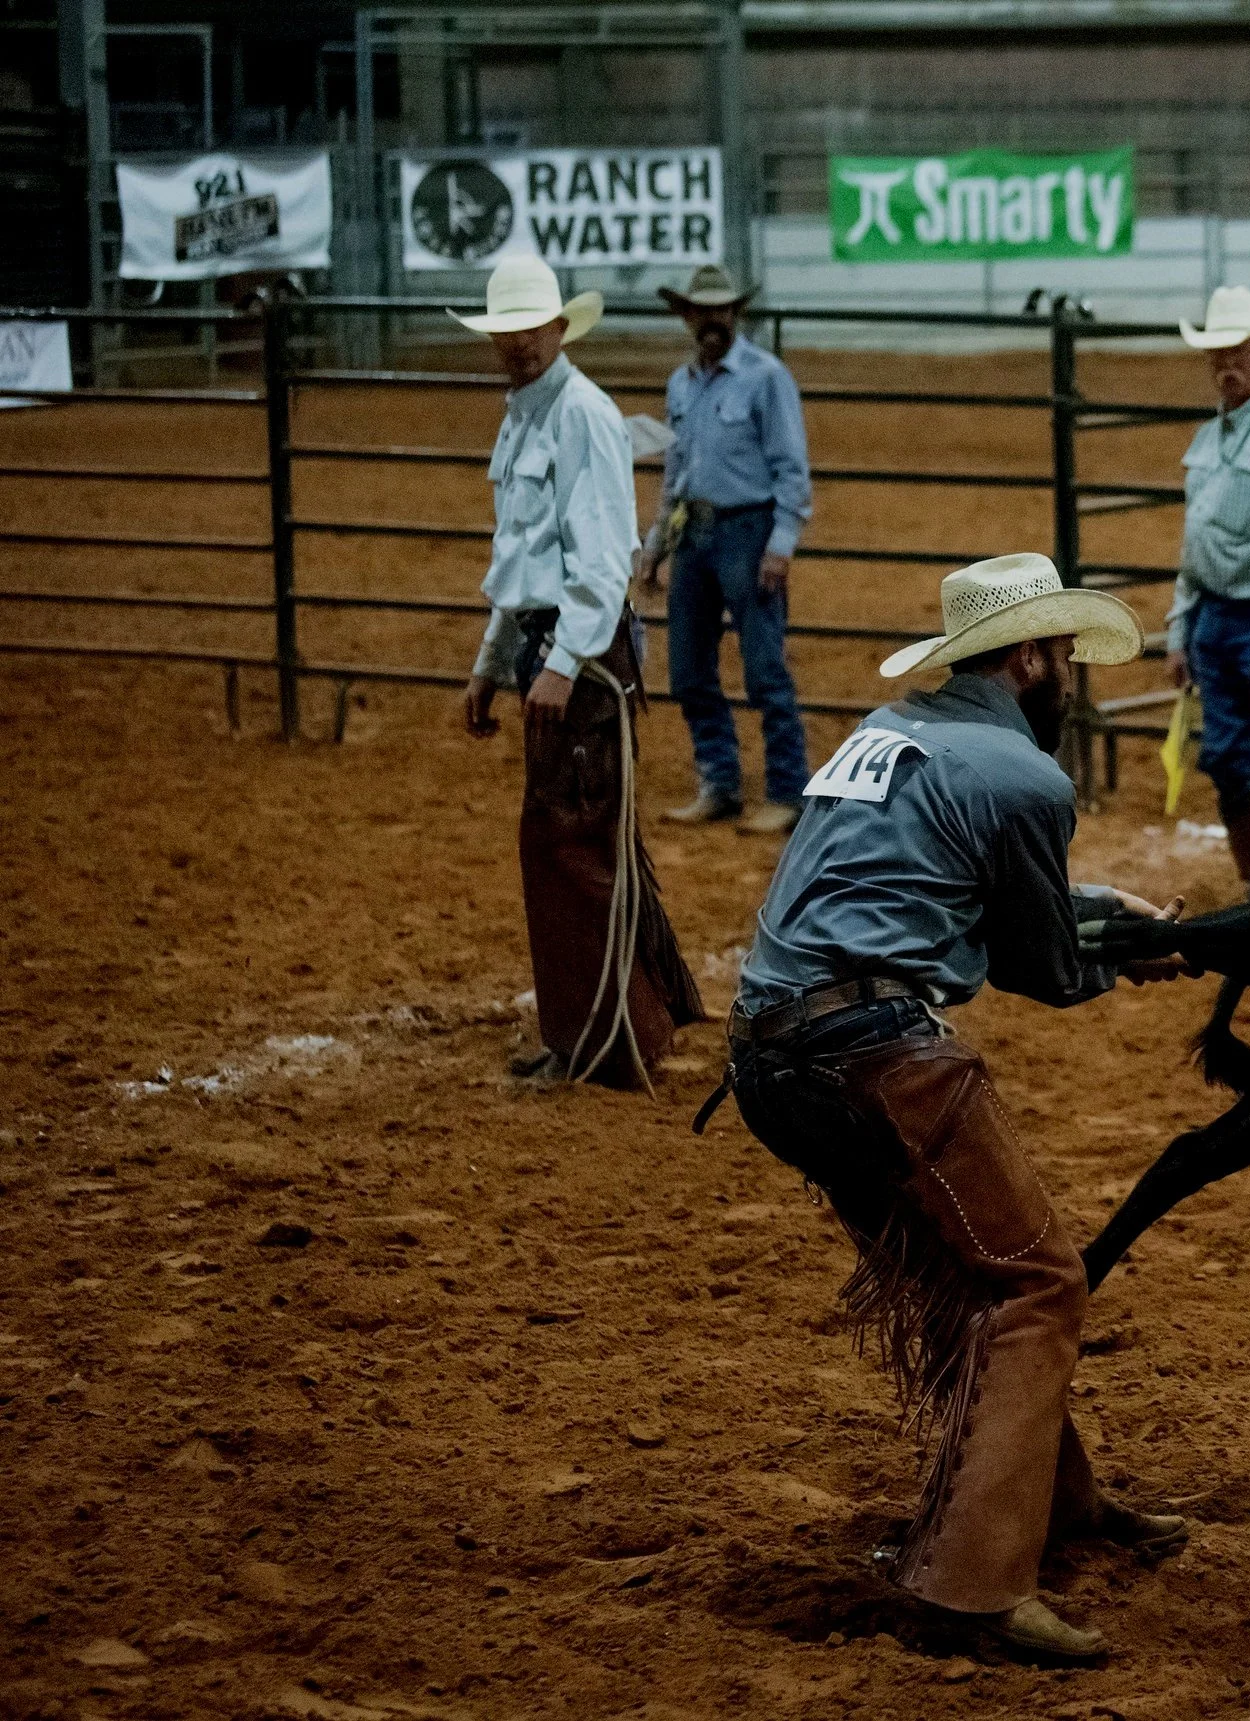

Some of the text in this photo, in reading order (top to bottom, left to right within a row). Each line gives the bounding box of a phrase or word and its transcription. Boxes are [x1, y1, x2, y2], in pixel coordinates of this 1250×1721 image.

[527, 158, 710, 202] RANCH
[913, 158, 1123, 250] Smarty
[529, 213, 712, 256] WATER
[824, 734, 911, 783] 114
